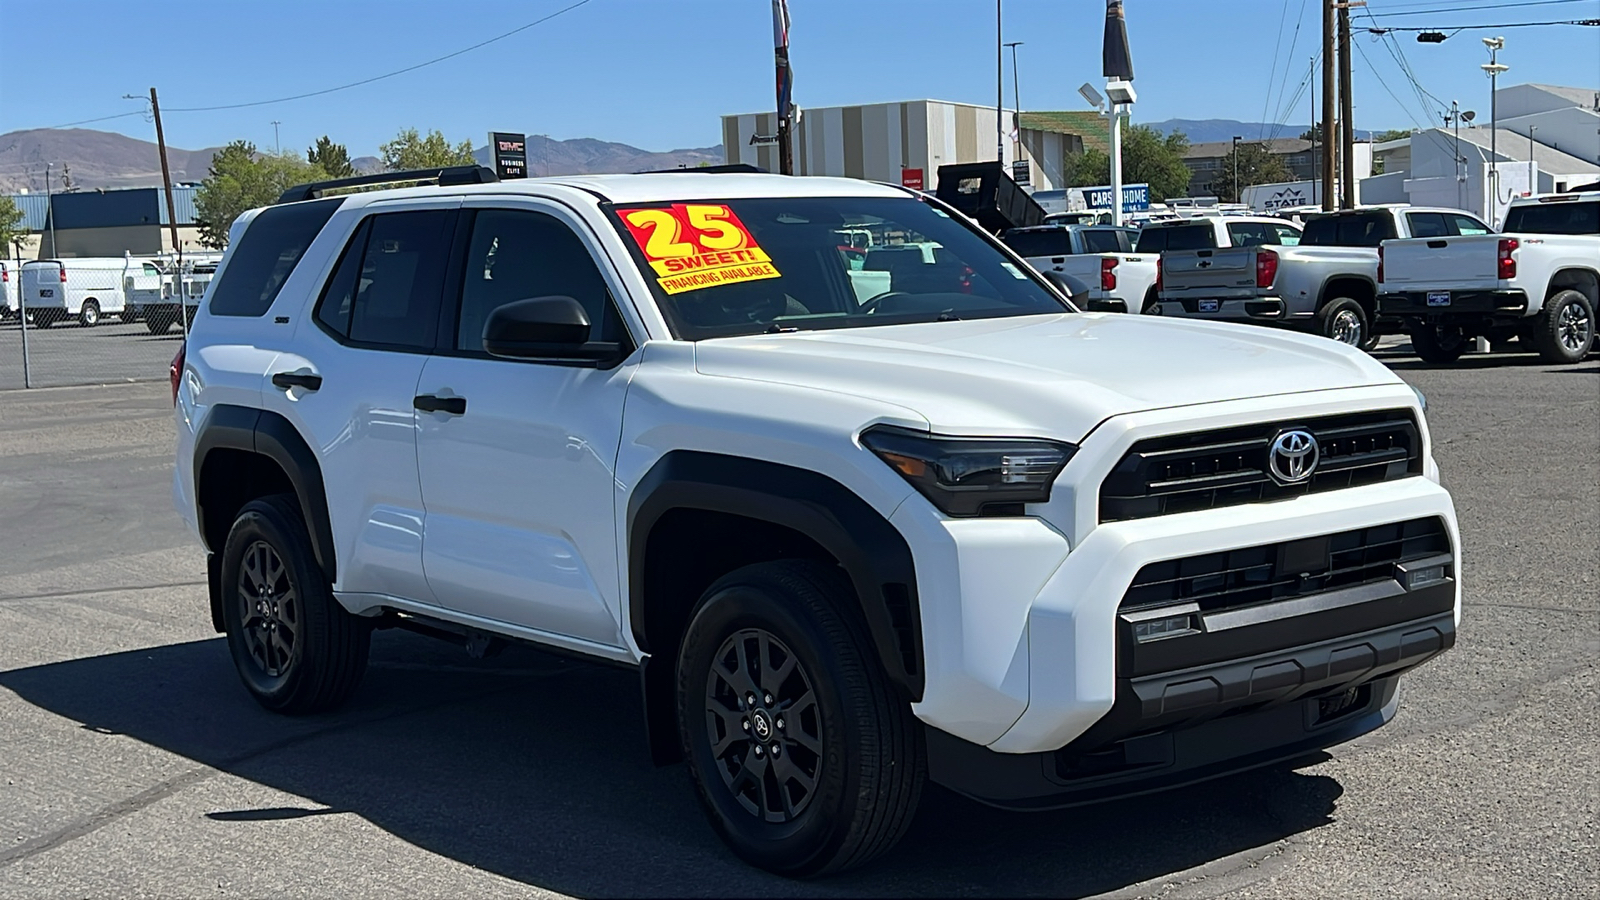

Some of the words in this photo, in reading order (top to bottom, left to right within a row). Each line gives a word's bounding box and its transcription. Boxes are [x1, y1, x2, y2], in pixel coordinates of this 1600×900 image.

[499, 141, 524, 151] GMC
[1124, 189, 1146, 204] HOME
[1264, 198, 1306, 208] STATE
[626, 205, 748, 258] 25
[664, 249, 757, 272] SWEET!
[663, 271, 720, 291] FINANCING
[722, 265, 775, 281] AVAILABLE
